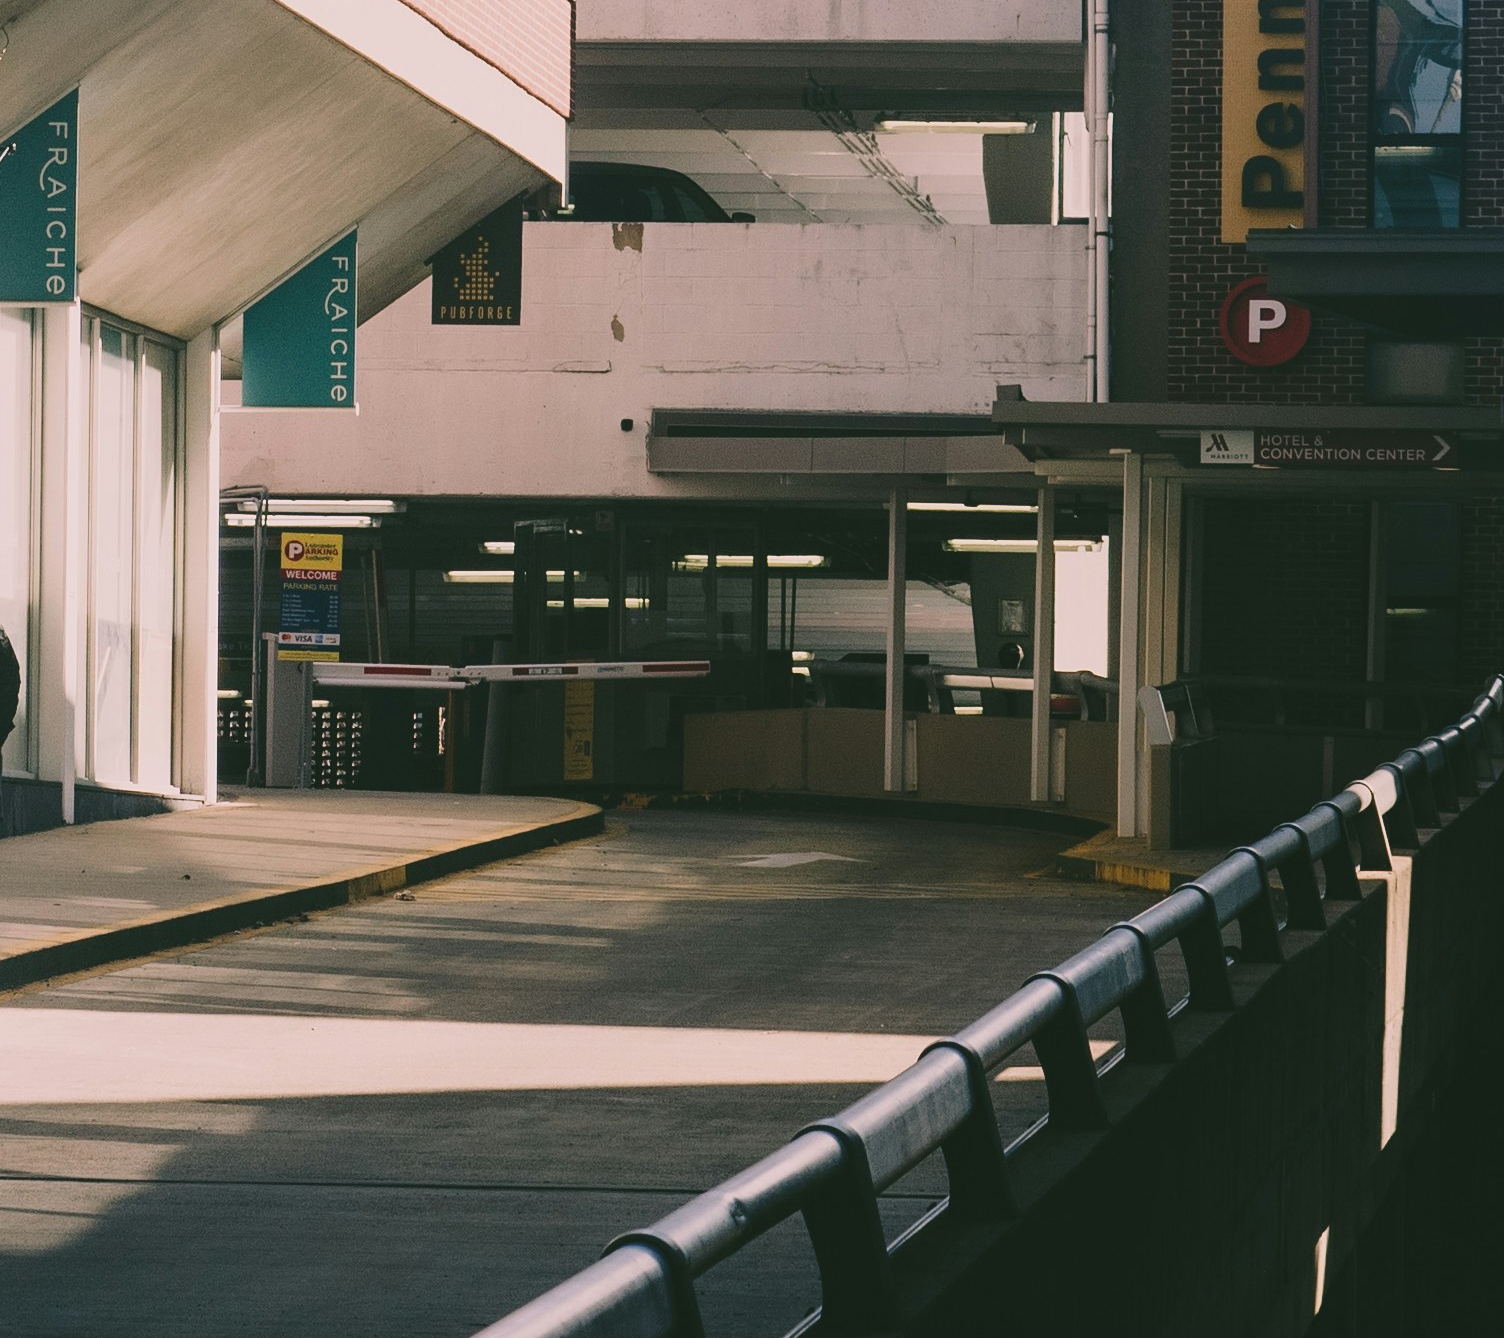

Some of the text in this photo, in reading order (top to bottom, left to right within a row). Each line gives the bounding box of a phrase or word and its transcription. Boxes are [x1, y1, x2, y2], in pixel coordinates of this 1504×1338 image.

[439, 306, 514, 320] PUBFORGE
[1245, 299, 1288, 343] P
[1260, 435, 1324, 447] HOTEL &
[1259, 448, 1425, 461] CONVENTION CENTER
[285, 570, 338, 581] WELCOME
[283, 582, 338, 592] PARKING RATE
